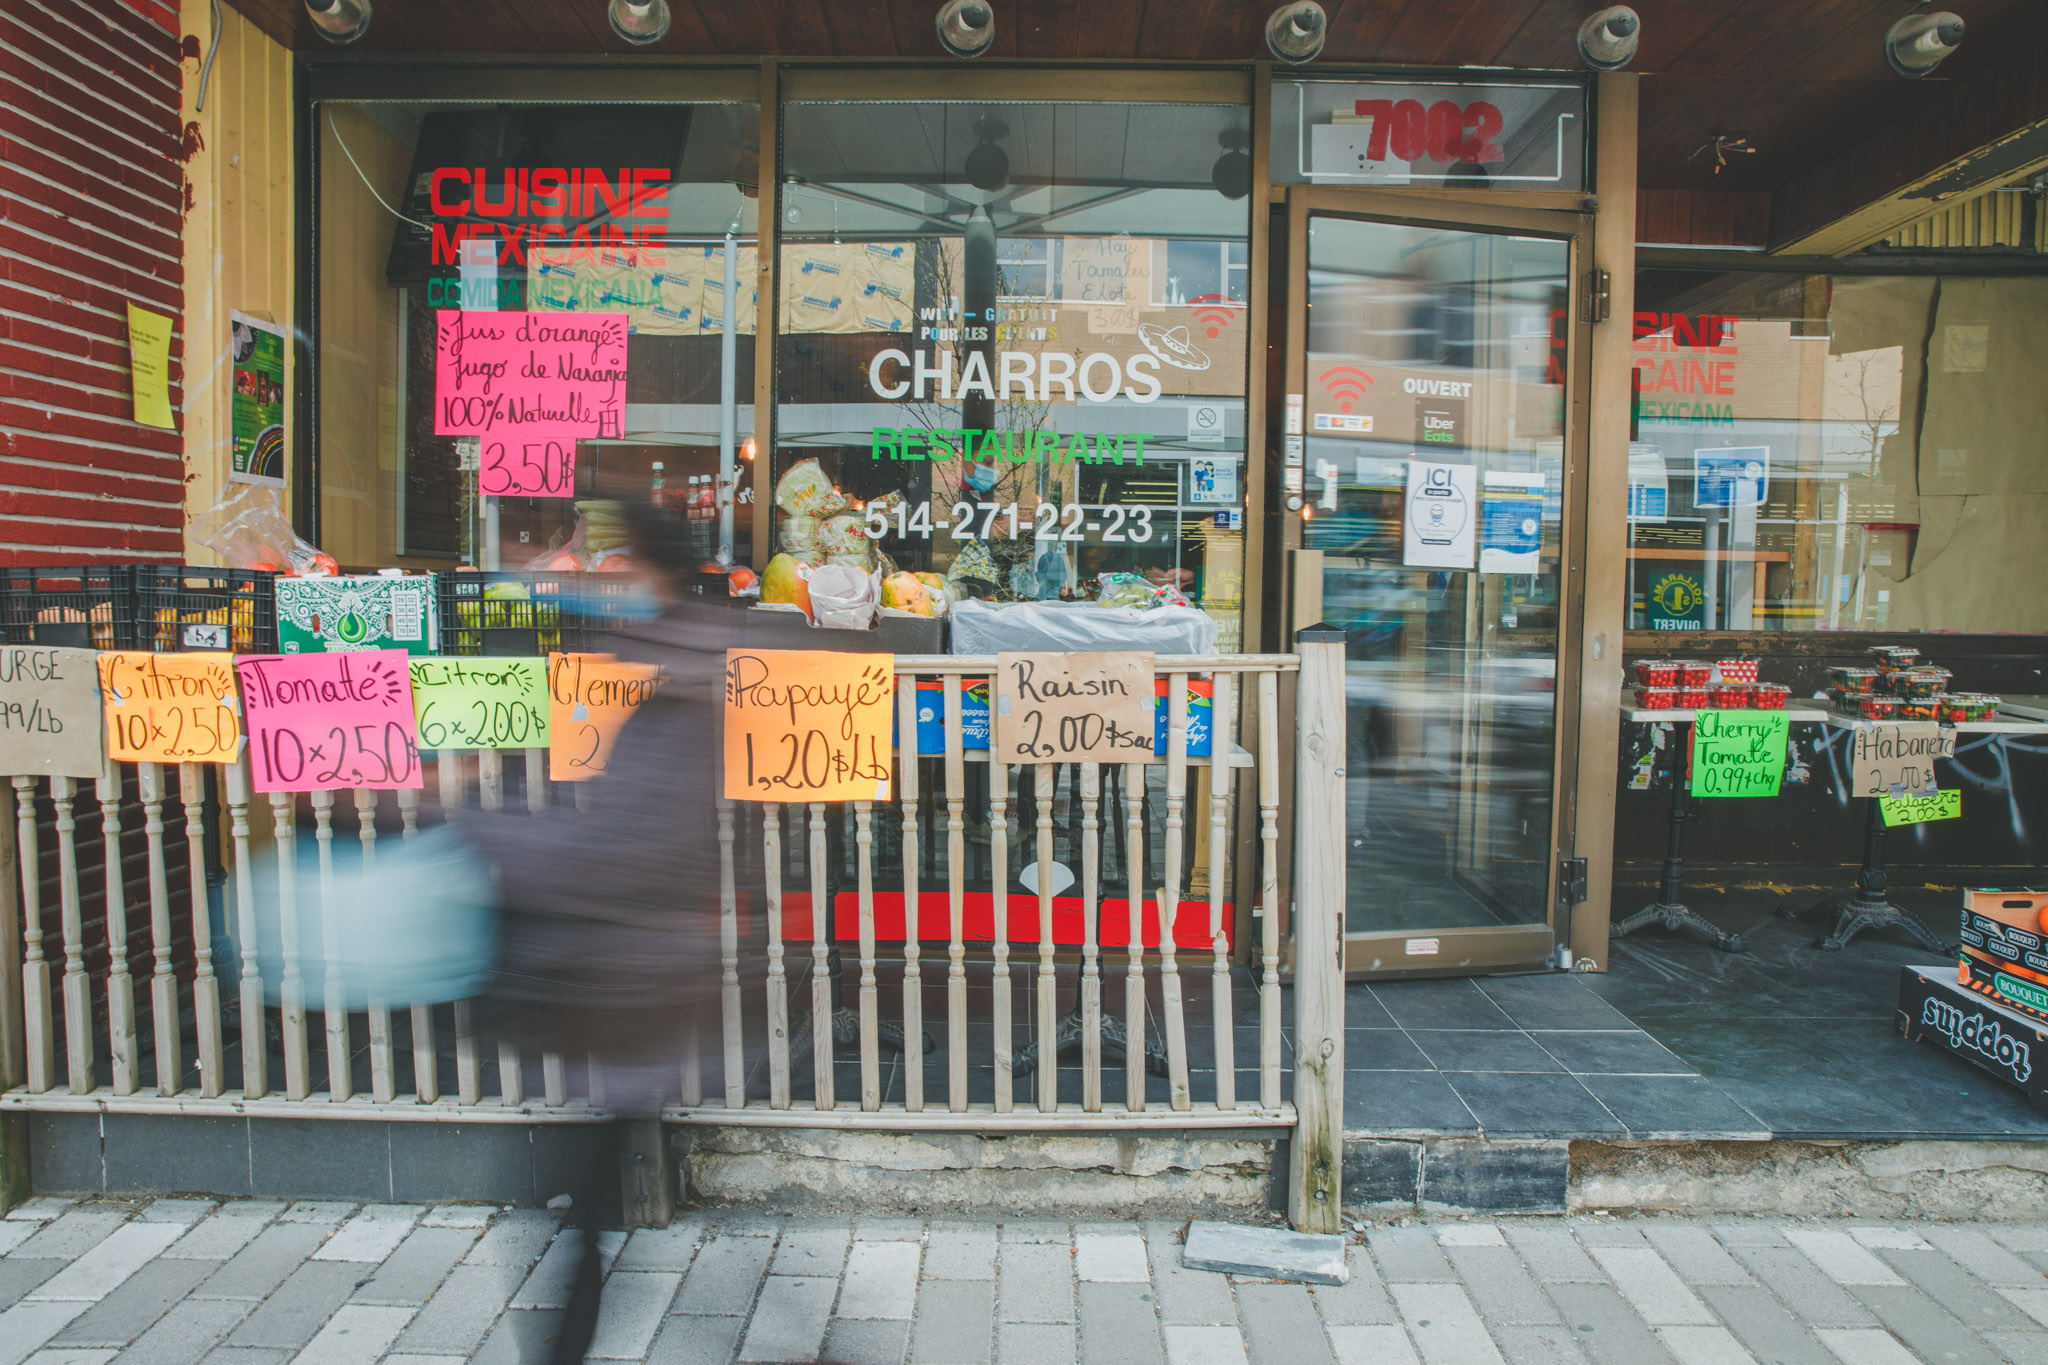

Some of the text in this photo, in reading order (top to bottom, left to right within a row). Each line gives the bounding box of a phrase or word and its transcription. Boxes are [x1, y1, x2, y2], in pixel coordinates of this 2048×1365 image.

[1355, 99, 1504, 163] 7002
[431, 167, 671, 217] CUISINE
[431, 223, 667, 267] MEXICAINE
[427, 277, 523, 308] COMIDA
[528, 277, 664, 310] MEXICANA
[921, 326, 958, 342] POUR
[964, 326, 988, 341] LES
[985, 308, 1058, 322] GRATUIT
[449, 311, 505, 356] Jus
[516, 315, 616, 365] d'orange
[521, 350, 550, 378] de
[557, 353, 627, 403] Naranja
[869, 348, 1162, 403] CHARROS
[1404, 378, 1472, 398] OUVERT
[444, 391, 598, 431] 100% Naturelle
[1424, 416, 1455, 430] Uber
[872, 427, 1154, 466] RESTAURANT
[1424, 429, 1455, 443] Eats
[482, 441, 574, 494] 3,50$
[1426, 468, 1453, 487] ICI
[864, 501, 1153, 544] 514-271-22-23
[107, 654, 225, 700] Citron
[418, 661, 522, 687] Citron
[1011, 660, 1129, 703] Raisin
[729, 655, 881, 741] Papaye
[1700, 712, 1772, 752] Cherry
[1862, 727, 1955, 761] Habanero
[1697, 738, 1774, 767] Tomate
[1991, 941, 2015, 957] BOUQUET
[2008, 931, 2037, 946] BOUQUET
[2000, 978, 2048, 1007] BOUQUET
